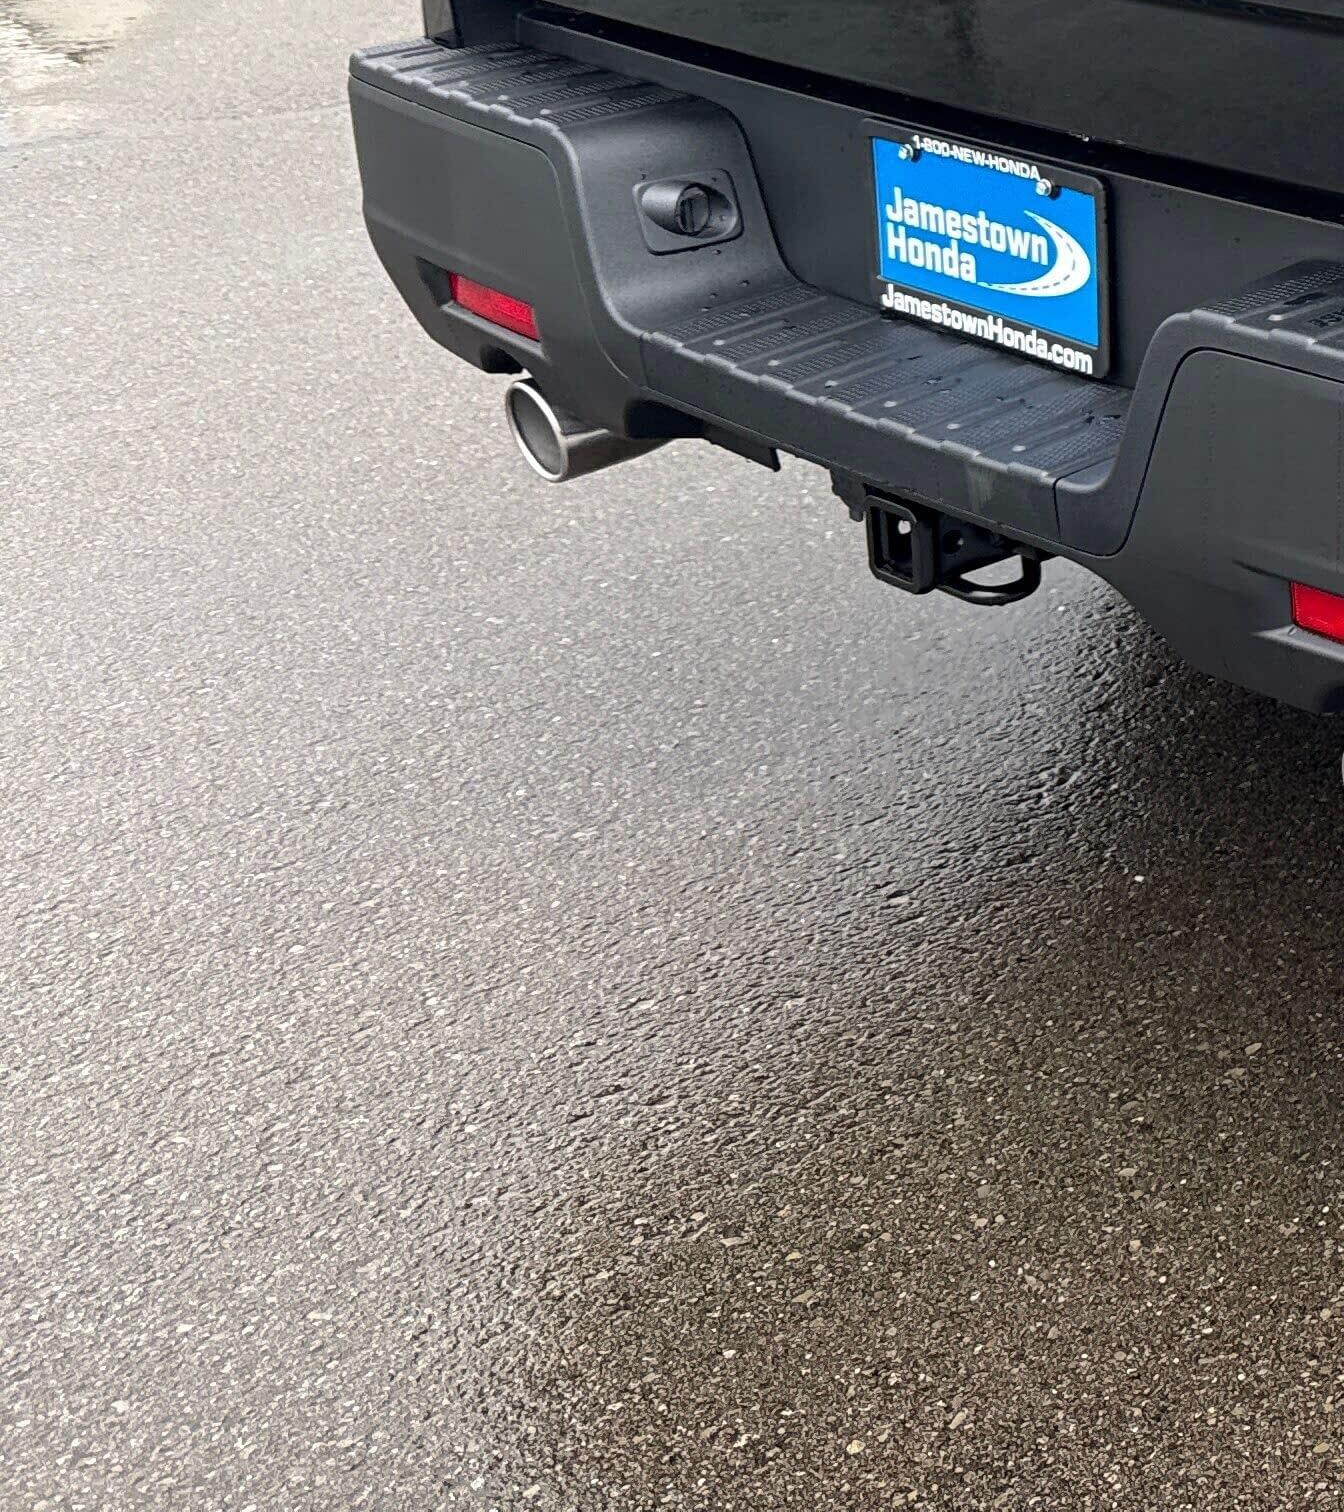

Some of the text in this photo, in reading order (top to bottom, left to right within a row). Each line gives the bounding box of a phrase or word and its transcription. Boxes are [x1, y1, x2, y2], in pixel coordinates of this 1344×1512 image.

[911, 135, 1041, 182] 1-800-NEW-HONDA
[885, 186, 1049, 266] Jamestown
[887, 222, 978, 284] Honda
[881, 284, 1093, 375] JamestownHonda.com
